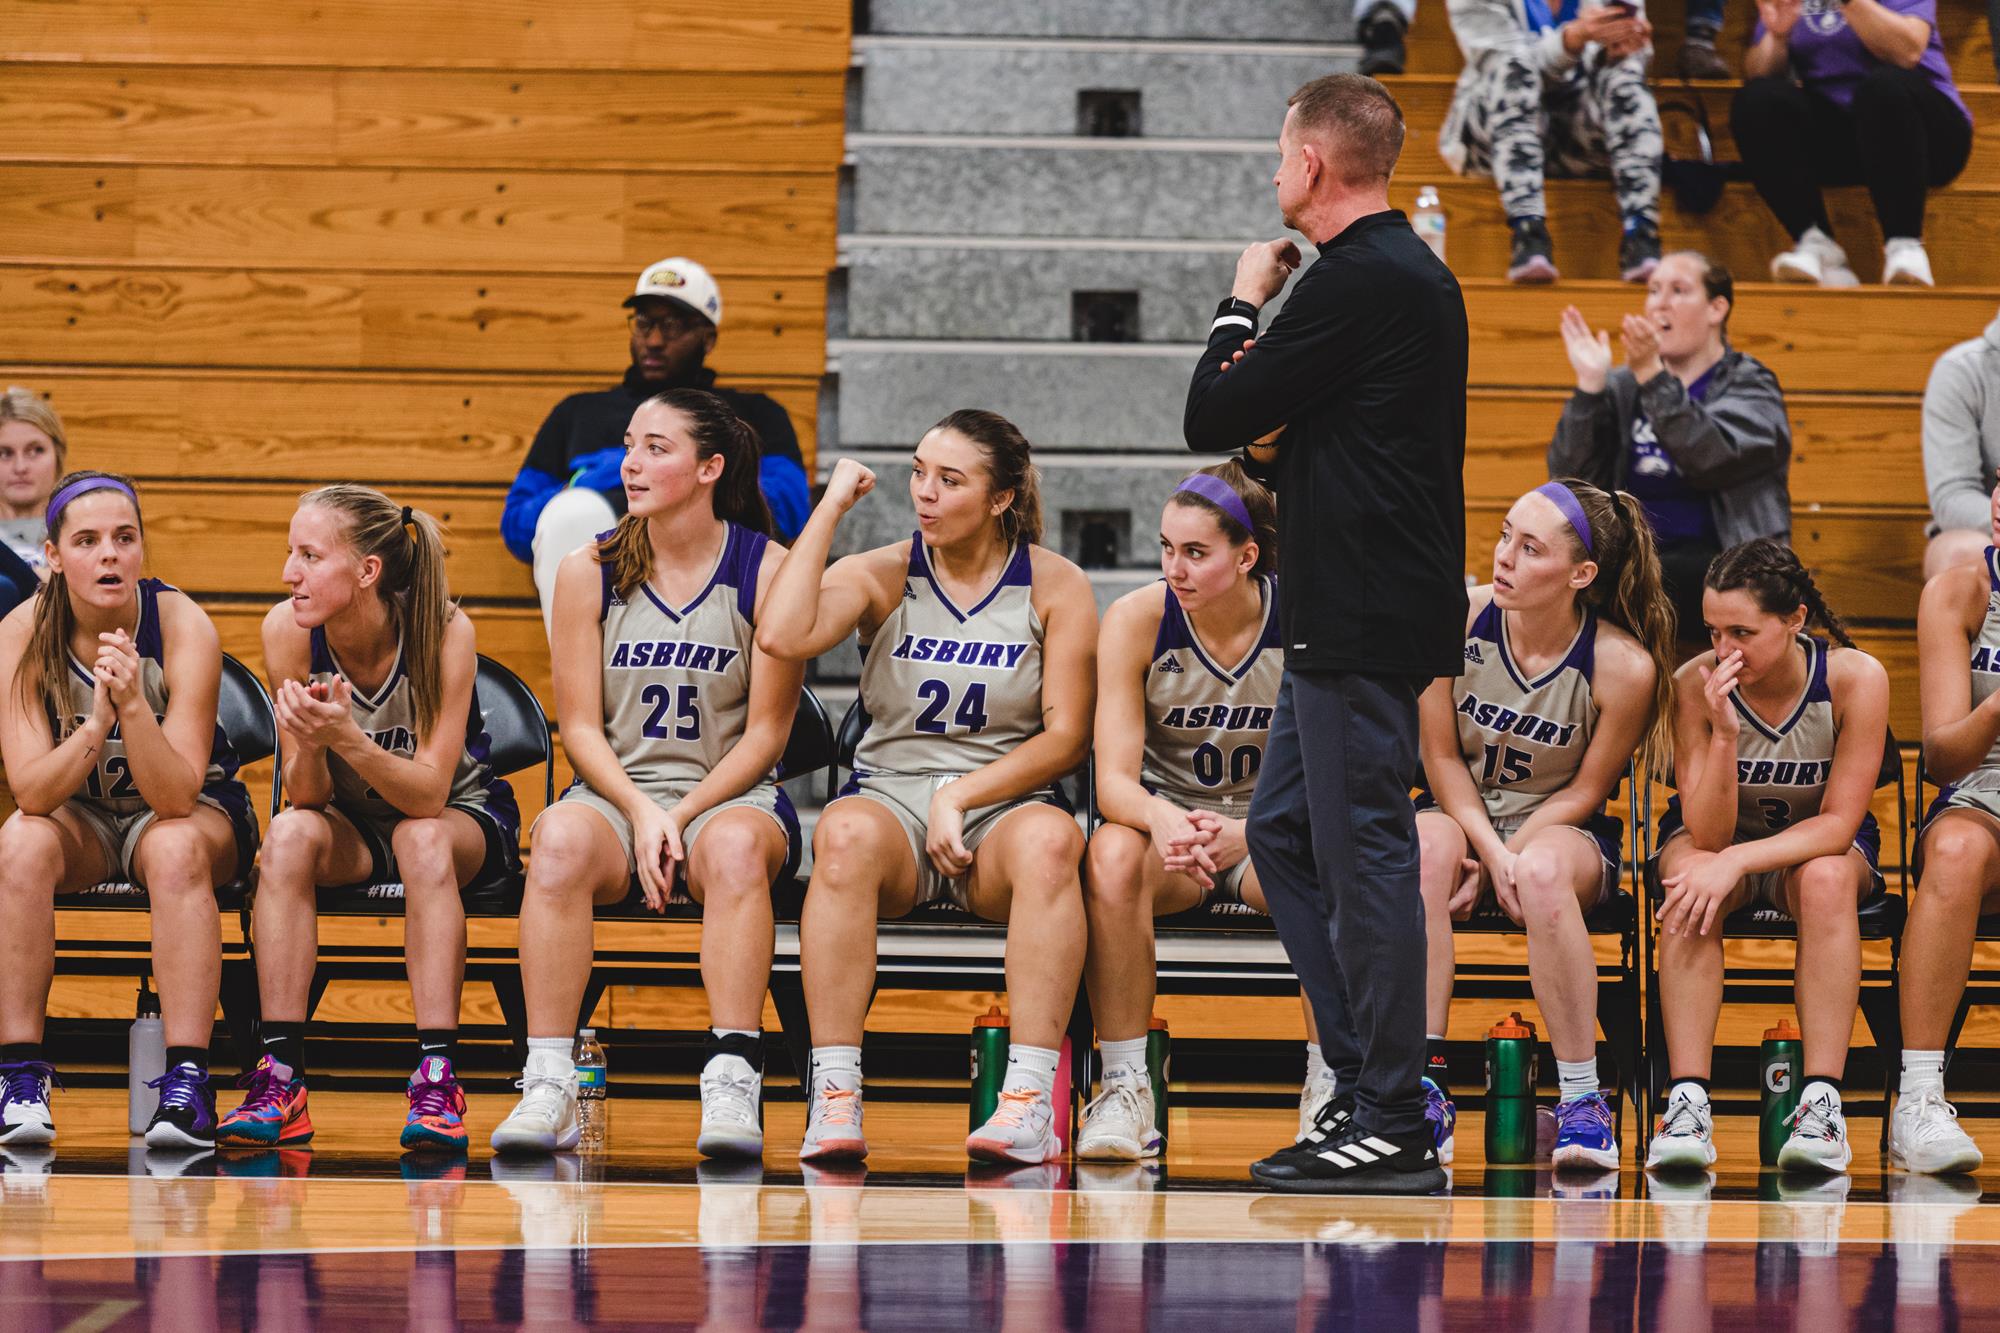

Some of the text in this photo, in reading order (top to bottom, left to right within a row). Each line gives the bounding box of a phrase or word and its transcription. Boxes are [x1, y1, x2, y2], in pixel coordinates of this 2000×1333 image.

[606, 640, 741, 675] ASBURY
[890, 633, 1035, 670] ASBURY
[641, 684, 701, 741] 25
[914, 678, 989, 735] 24
[1159, 704, 1277, 731] ASBUR
[1457, 691, 1582, 748] ASBURY
[1191, 740, 1263, 788] 00
[1481, 742, 1534, 785] 15
[1756, 796, 1792, 830] 3
[368, 884, 405, 898] #TEA
[1766, 1062, 1791, 1094] G
